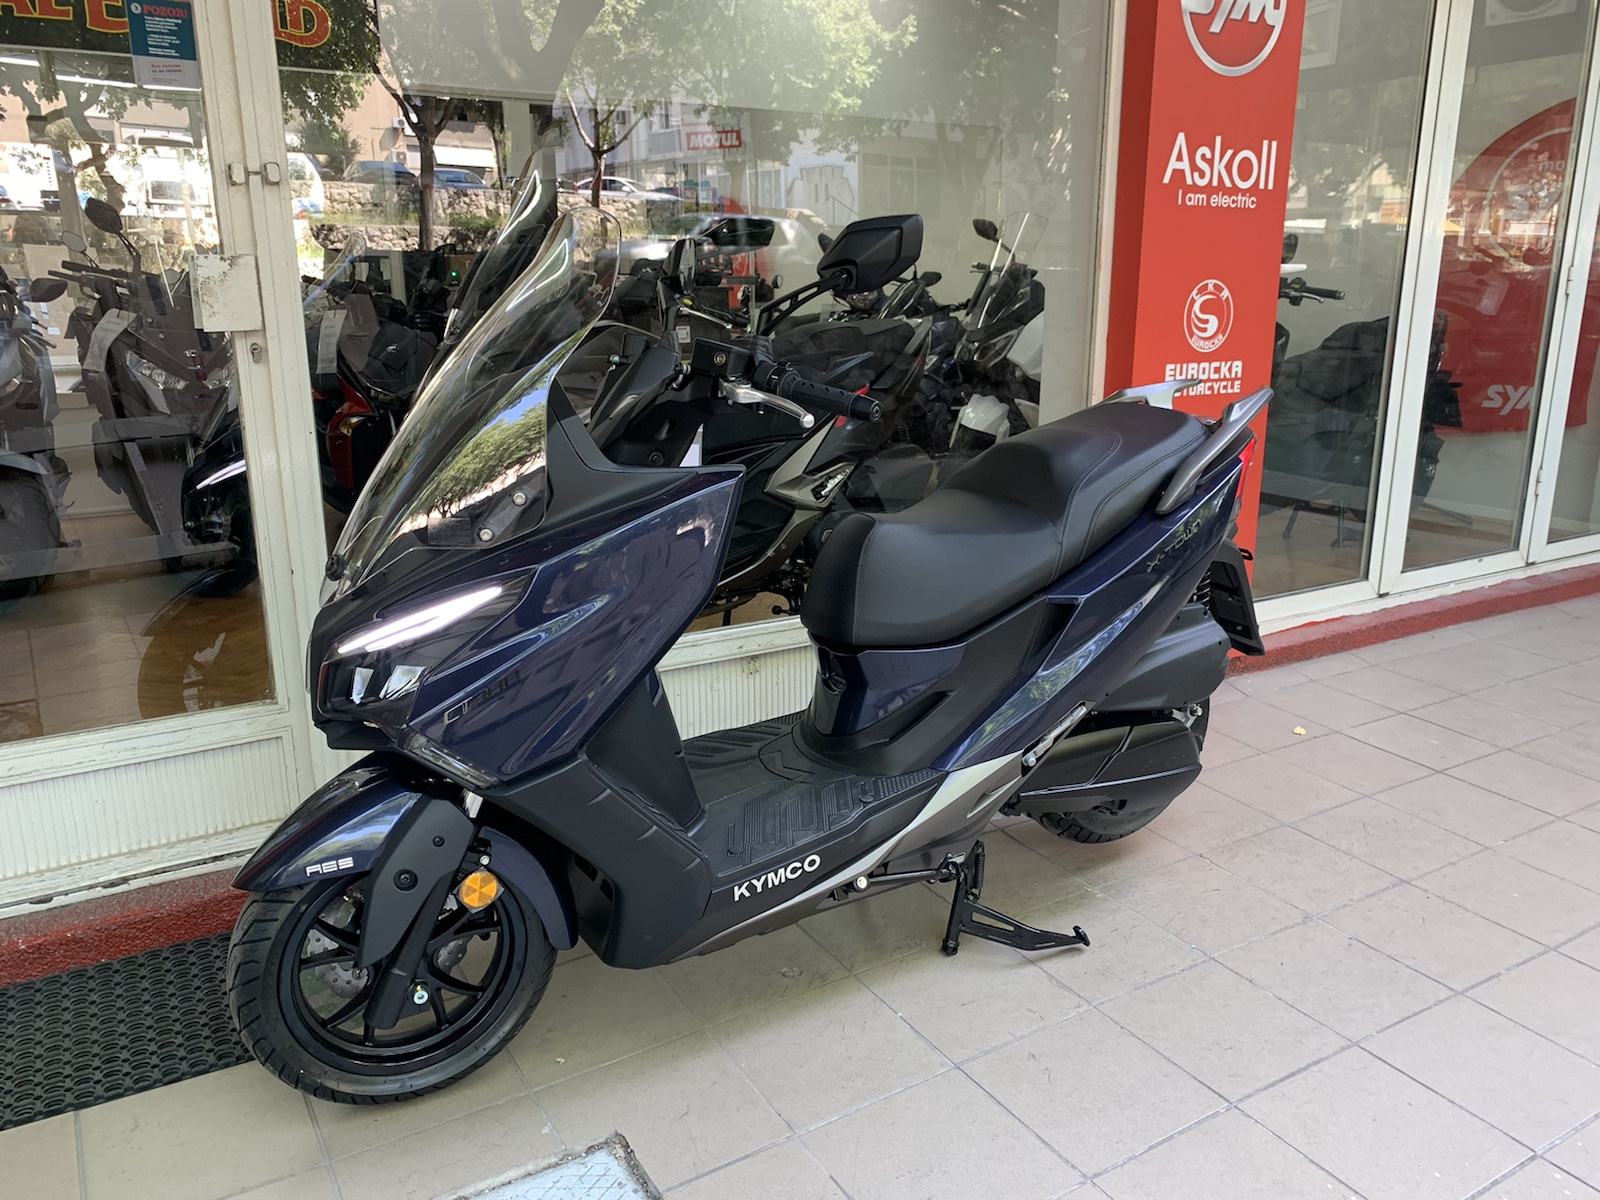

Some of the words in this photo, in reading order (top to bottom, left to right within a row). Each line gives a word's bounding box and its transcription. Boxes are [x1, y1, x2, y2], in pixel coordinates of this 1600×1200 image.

[690, 133, 740, 148] MOTUL
[1163, 132, 1278, 190] Askoll
[1185, 192, 1207, 207] am
[1210, 193, 1257, 209] electric
[1165, 360, 1243, 381] EUROCKA
[1174, 380, 1242, 397] ORCYCLE
[733, 853, 822, 902] KYMCO
